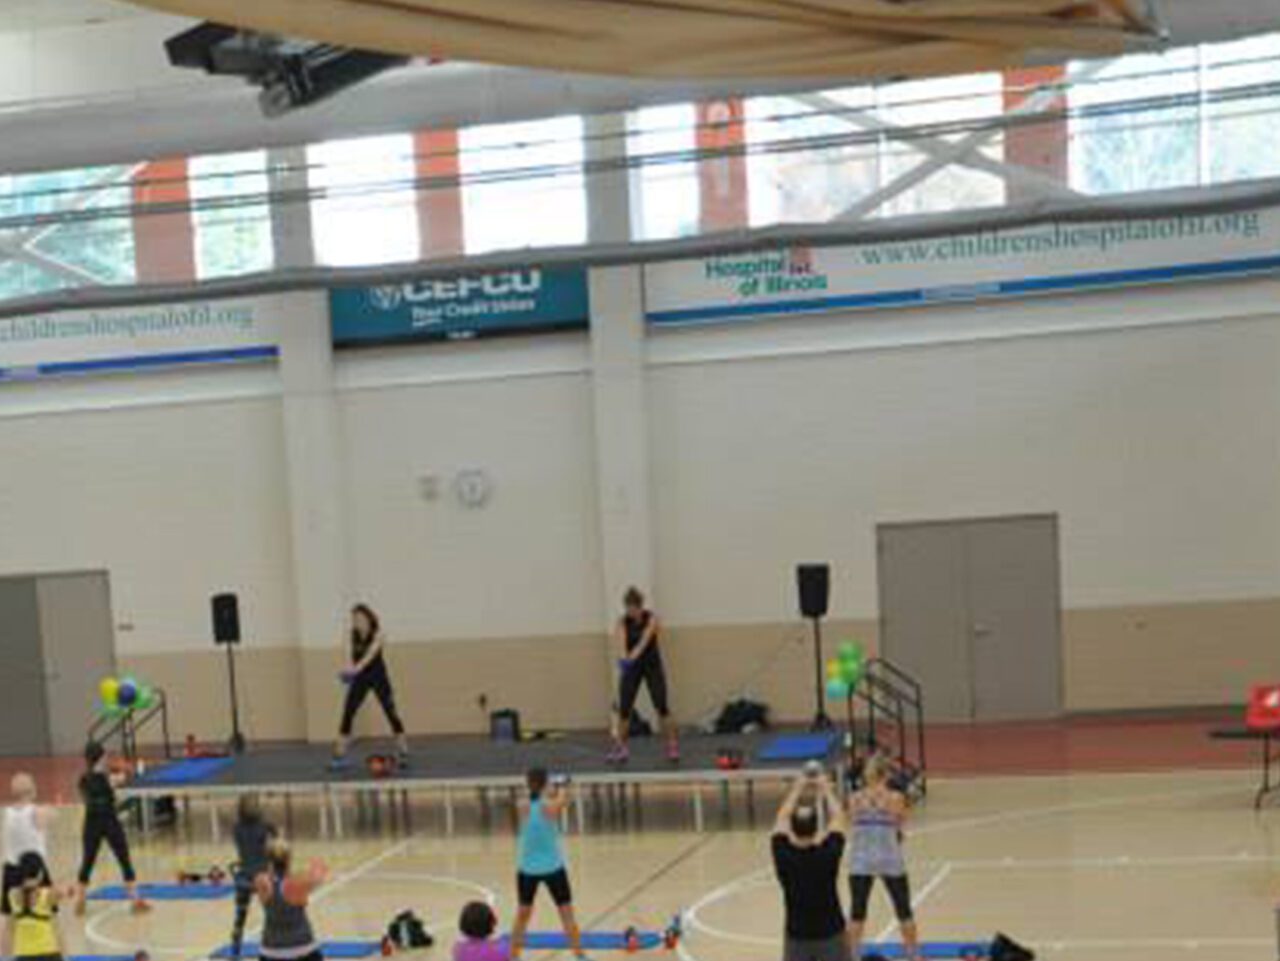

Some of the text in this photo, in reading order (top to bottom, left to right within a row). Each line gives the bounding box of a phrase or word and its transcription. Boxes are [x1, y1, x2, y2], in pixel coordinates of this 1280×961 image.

[706, 256, 785, 279] Hospital
[403, 270, 541, 301] CEFCU
[739, 273, 829, 296] of Illinois
